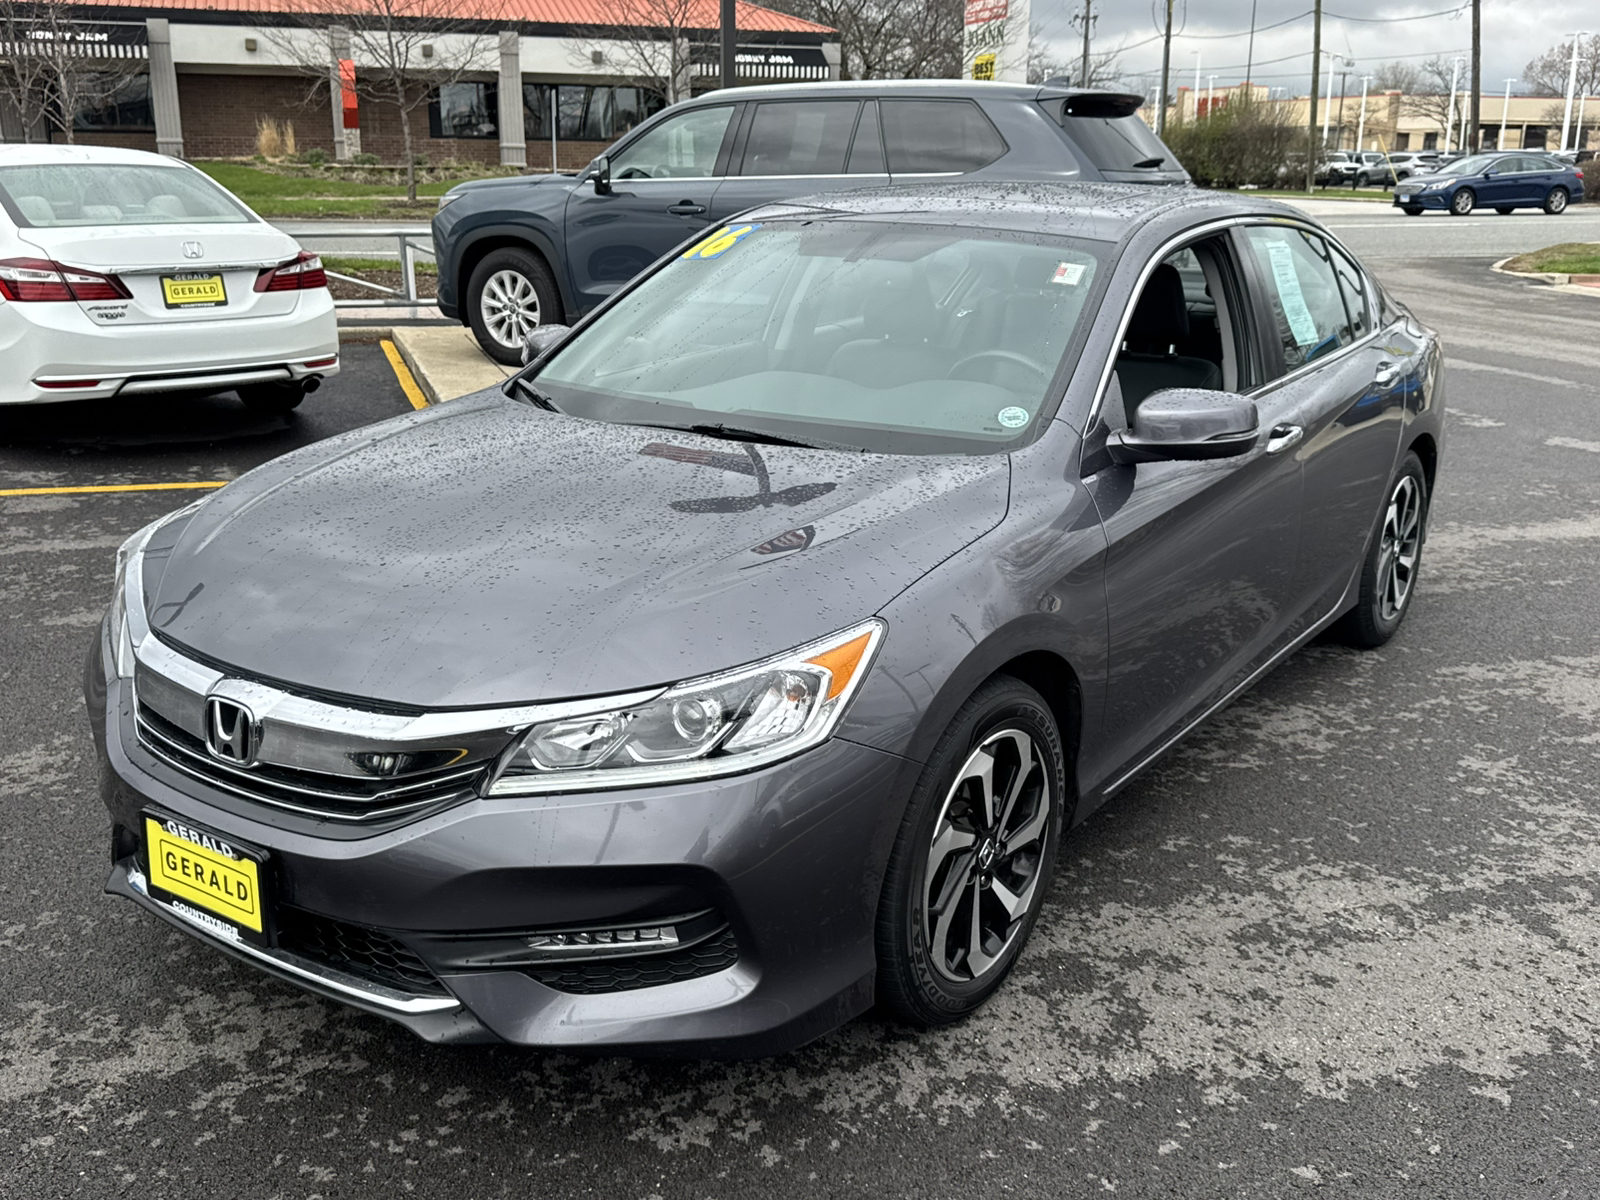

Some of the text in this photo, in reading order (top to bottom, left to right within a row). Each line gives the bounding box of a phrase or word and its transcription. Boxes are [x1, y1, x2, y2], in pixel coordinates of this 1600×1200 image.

[26, 31, 71, 40] HONY
[974, 61, 994, 75] BEST
[175, 273, 209, 281] GERALD
[173, 285, 216, 296] GERALD
[166, 820, 233, 858] GERALD
[165, 851, 248, 901] GERALD
[912, 907, 967, 1011] GOODYEAR
